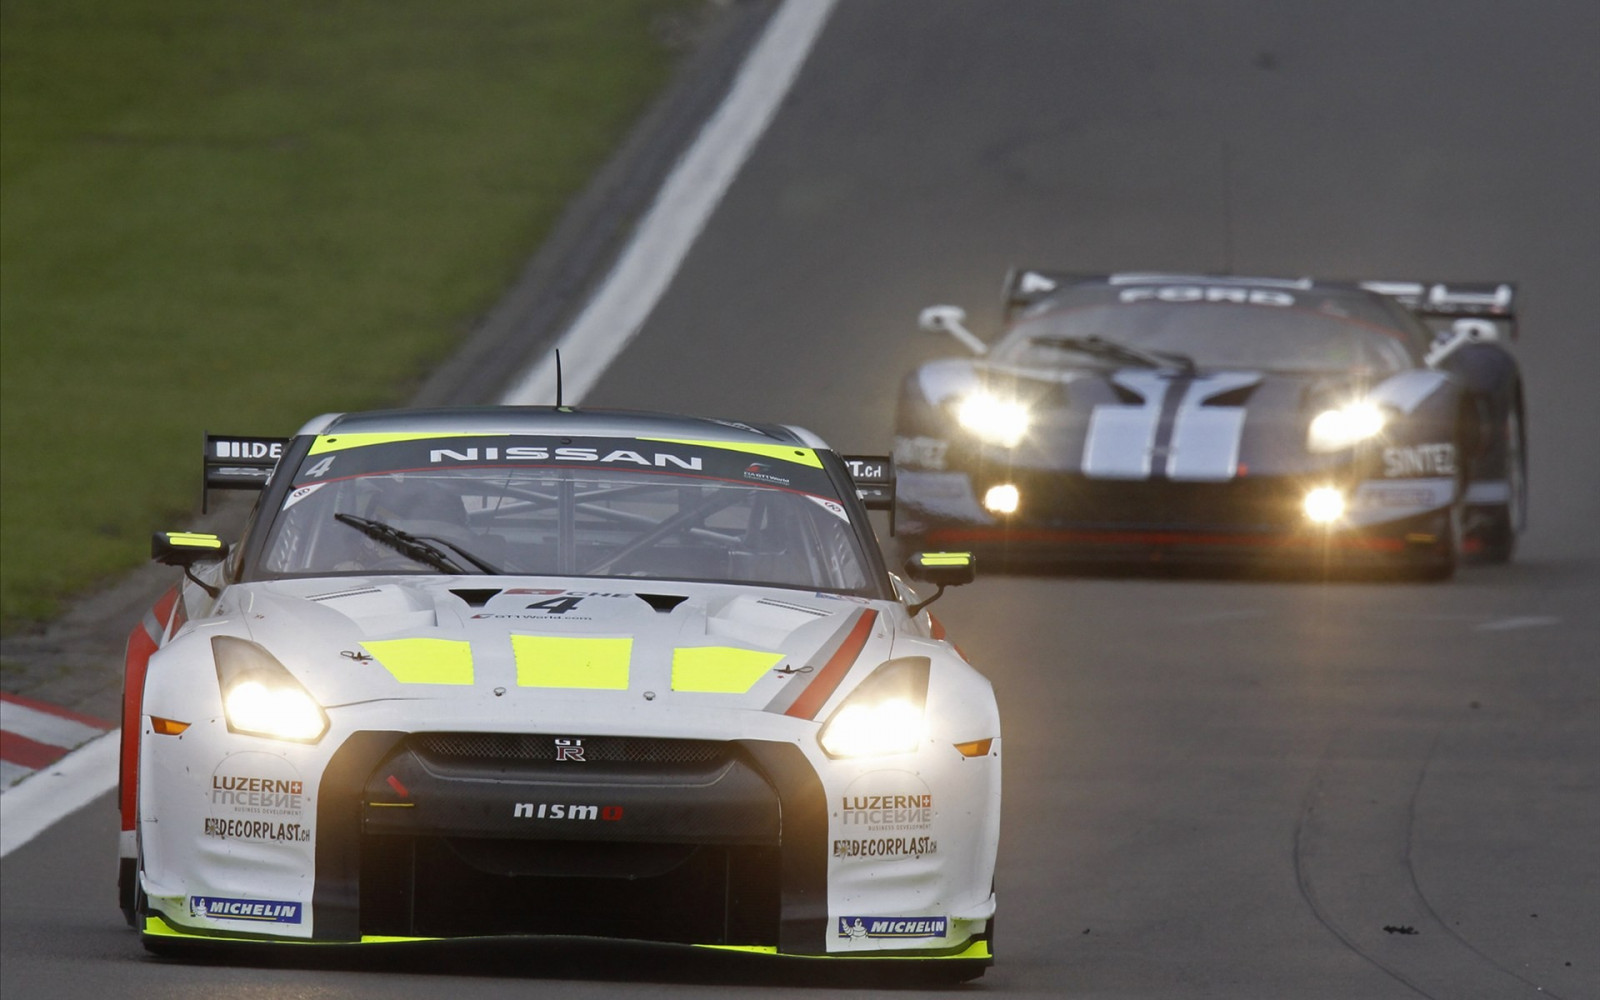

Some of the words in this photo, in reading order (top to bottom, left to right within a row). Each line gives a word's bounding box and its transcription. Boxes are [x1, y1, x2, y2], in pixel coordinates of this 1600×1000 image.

[1119, 286, 1296, 307] FORD
[305, 455, 336, 478] 4
[430, 447, 703, 471] NISSAN
[525, 596, 586, 614] 4
[554, 738, 586, 746] GT
[213, 775, 290, 794] LUZERN
[513, 802, 624, 822] nismo
[842, 795, 921, 811] LUZERN
[209, 901, 297, 918] MICHELIN
[870, 919, 945, 933] MICHELIN
